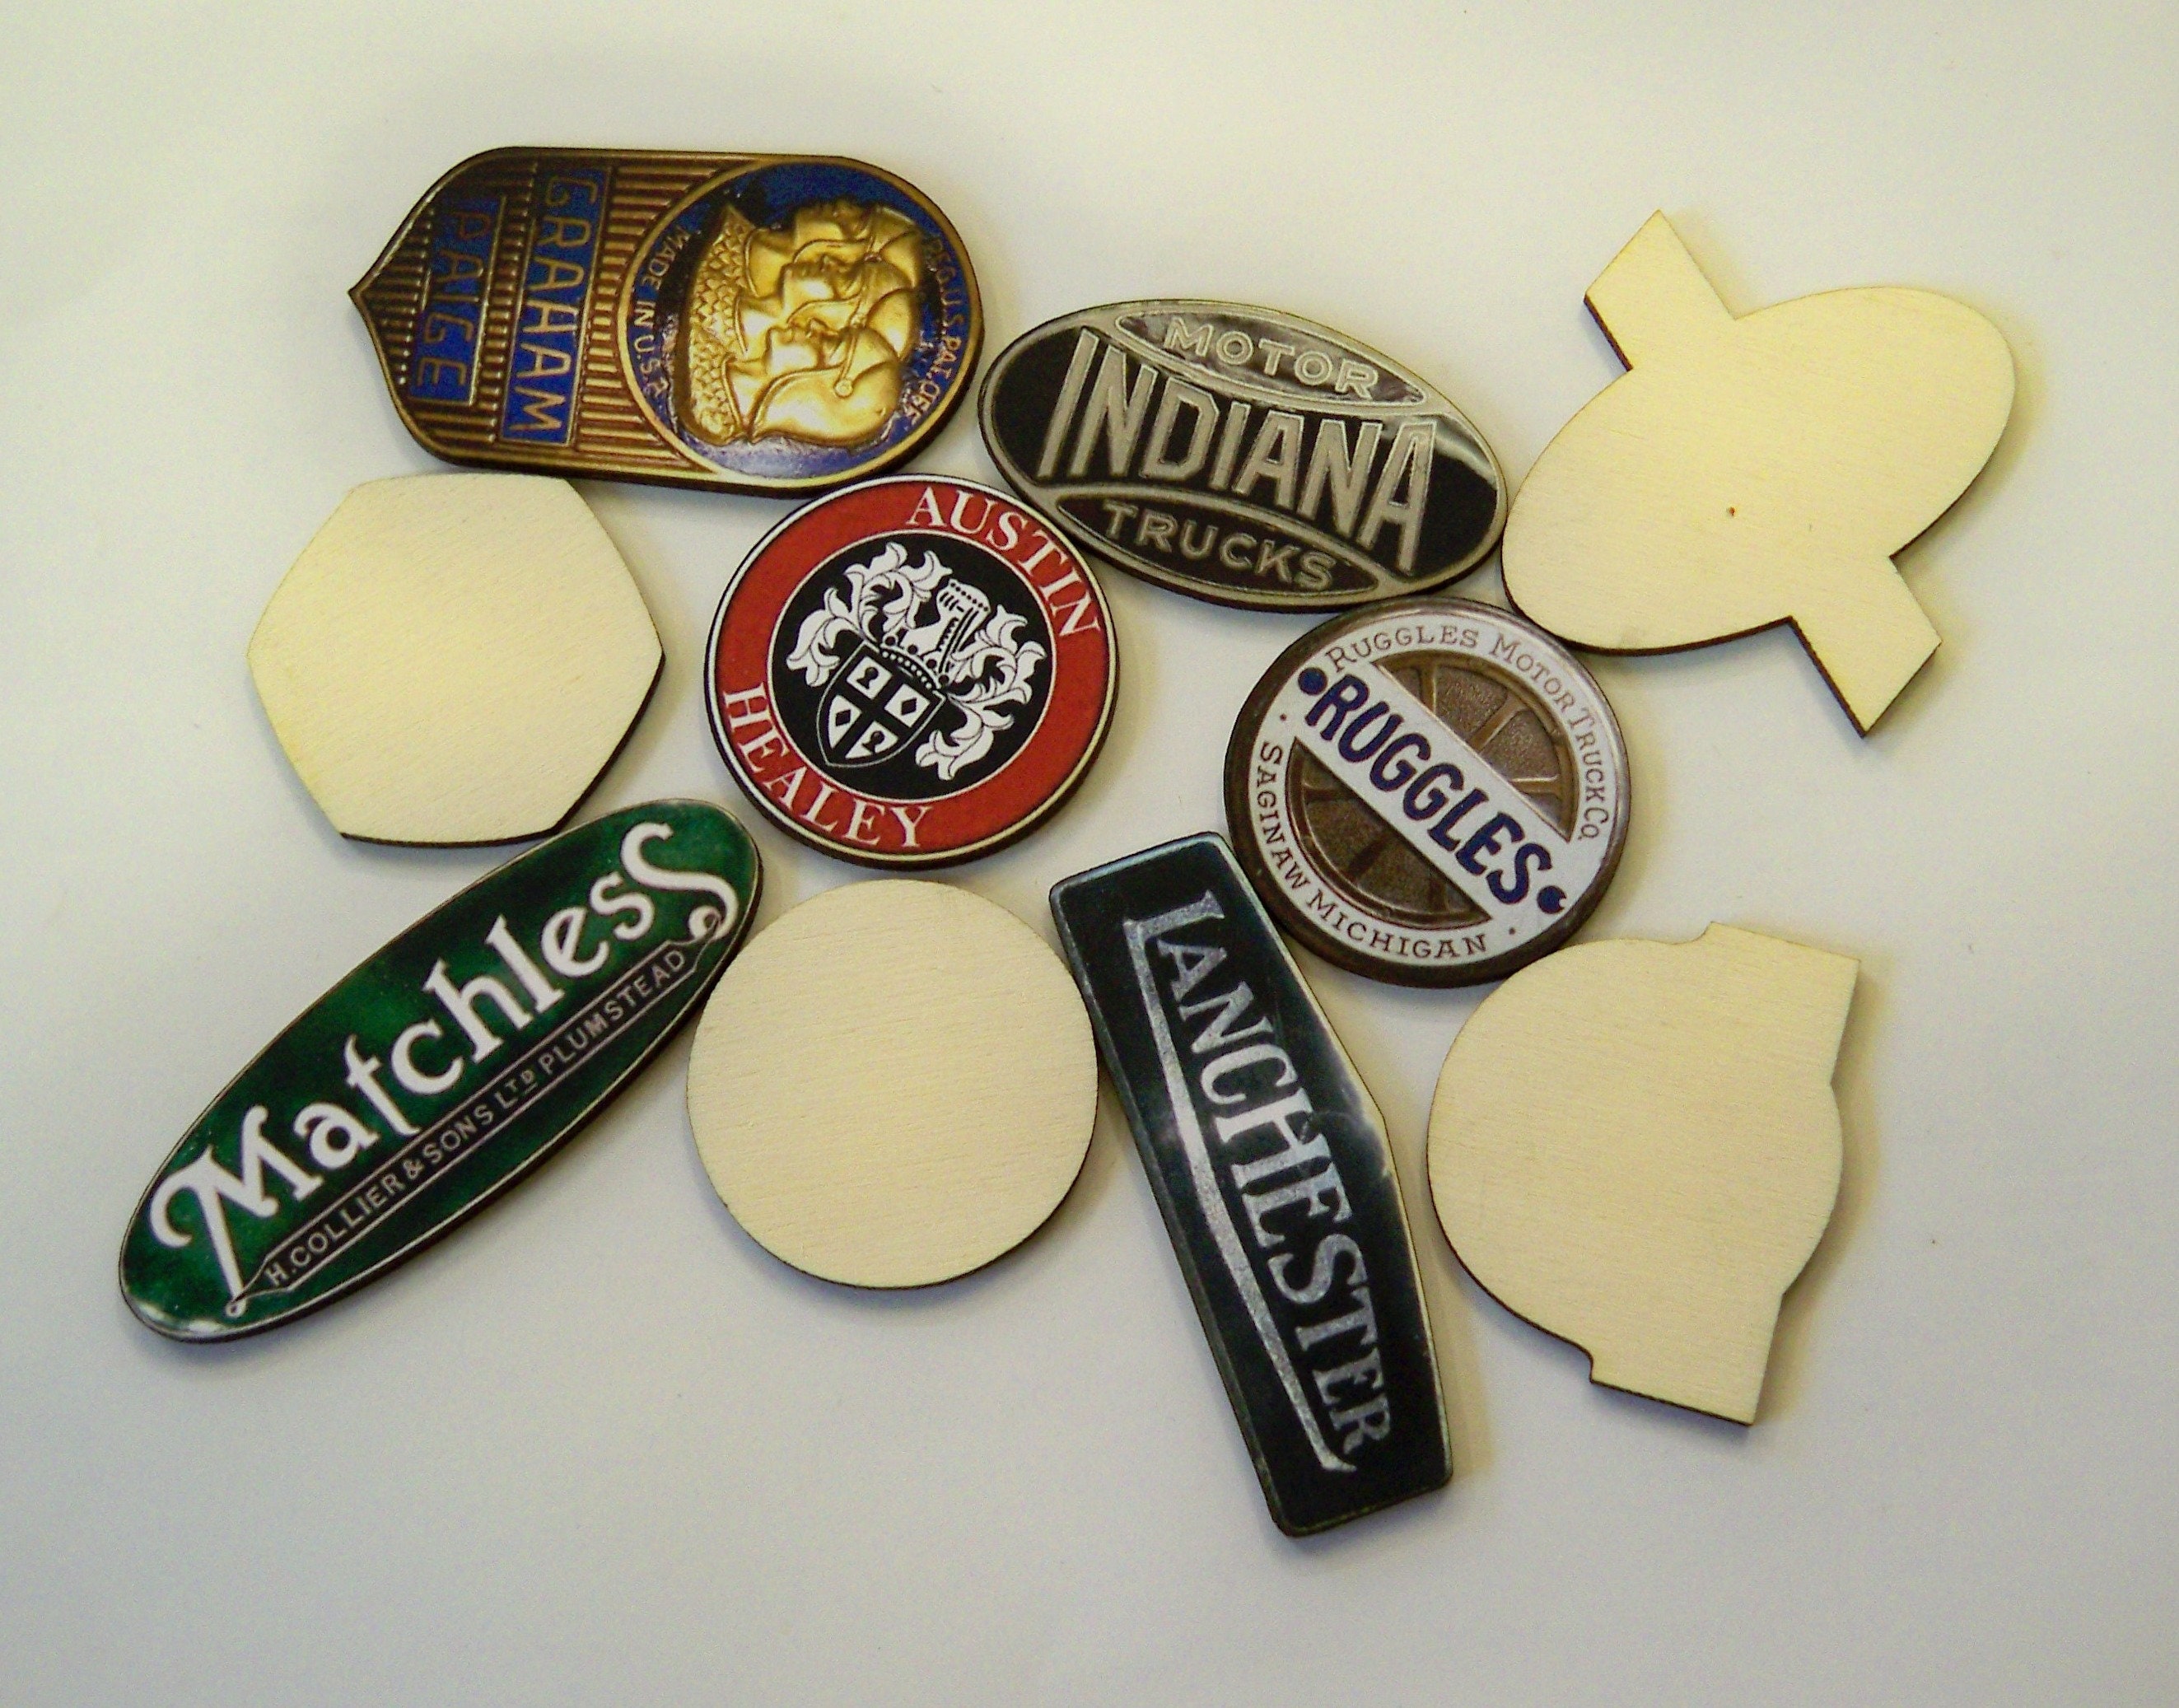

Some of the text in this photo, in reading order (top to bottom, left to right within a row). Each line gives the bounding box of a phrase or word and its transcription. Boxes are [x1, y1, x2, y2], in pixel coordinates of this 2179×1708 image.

[413, 210, 492, 392] PAIGE
[507, 173, 597, 435] GRAHAM
[633, 299, 656, 328] IN
[640, 226, 691, 290] MADE
[1162, 317, 1381, 399] MOTOR
[1035, 328, 1439, 575] INDIANA
[1101, 498, 1341, 593] TRUCKS
[908, 485, 1101, 639] AUSTIN
[722, 681, 932, 849] HEALEY
[1255, 740, 1487, 960] SAGINAW MICHIGAN
[1304, 673, 1553, 906] RUGGLES
[147, 822, 740, 1318] Matchless
[402, 1157, 426, 1181] &
[422, 1103, 495, 1165] SONS
[494, 1069, 539, 1109] LTD
[537, 949, 686, 1076] PLUMSTEAD
[1122, 889, 1392, 1474] LANCHESTER
